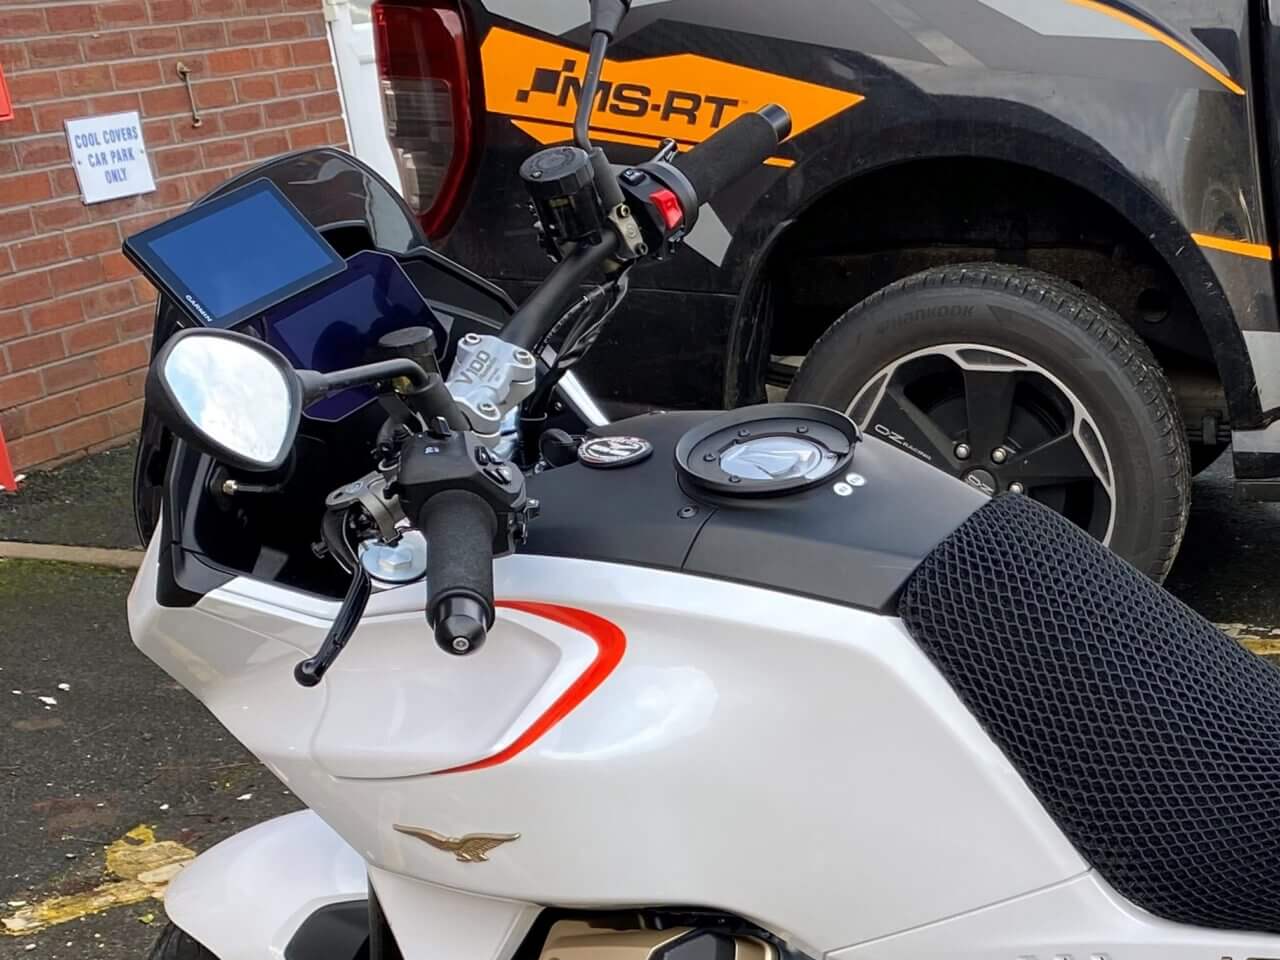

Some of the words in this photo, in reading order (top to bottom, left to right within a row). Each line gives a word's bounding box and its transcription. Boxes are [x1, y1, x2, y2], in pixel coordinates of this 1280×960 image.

[74, 131, 102, 149] COOL
[102, 126, 139, 144] COVERS
[87, 151, 108, 168] CAR
[110, 147, 135, 165] PARK
[104, 167, 127, 184] ONLY
